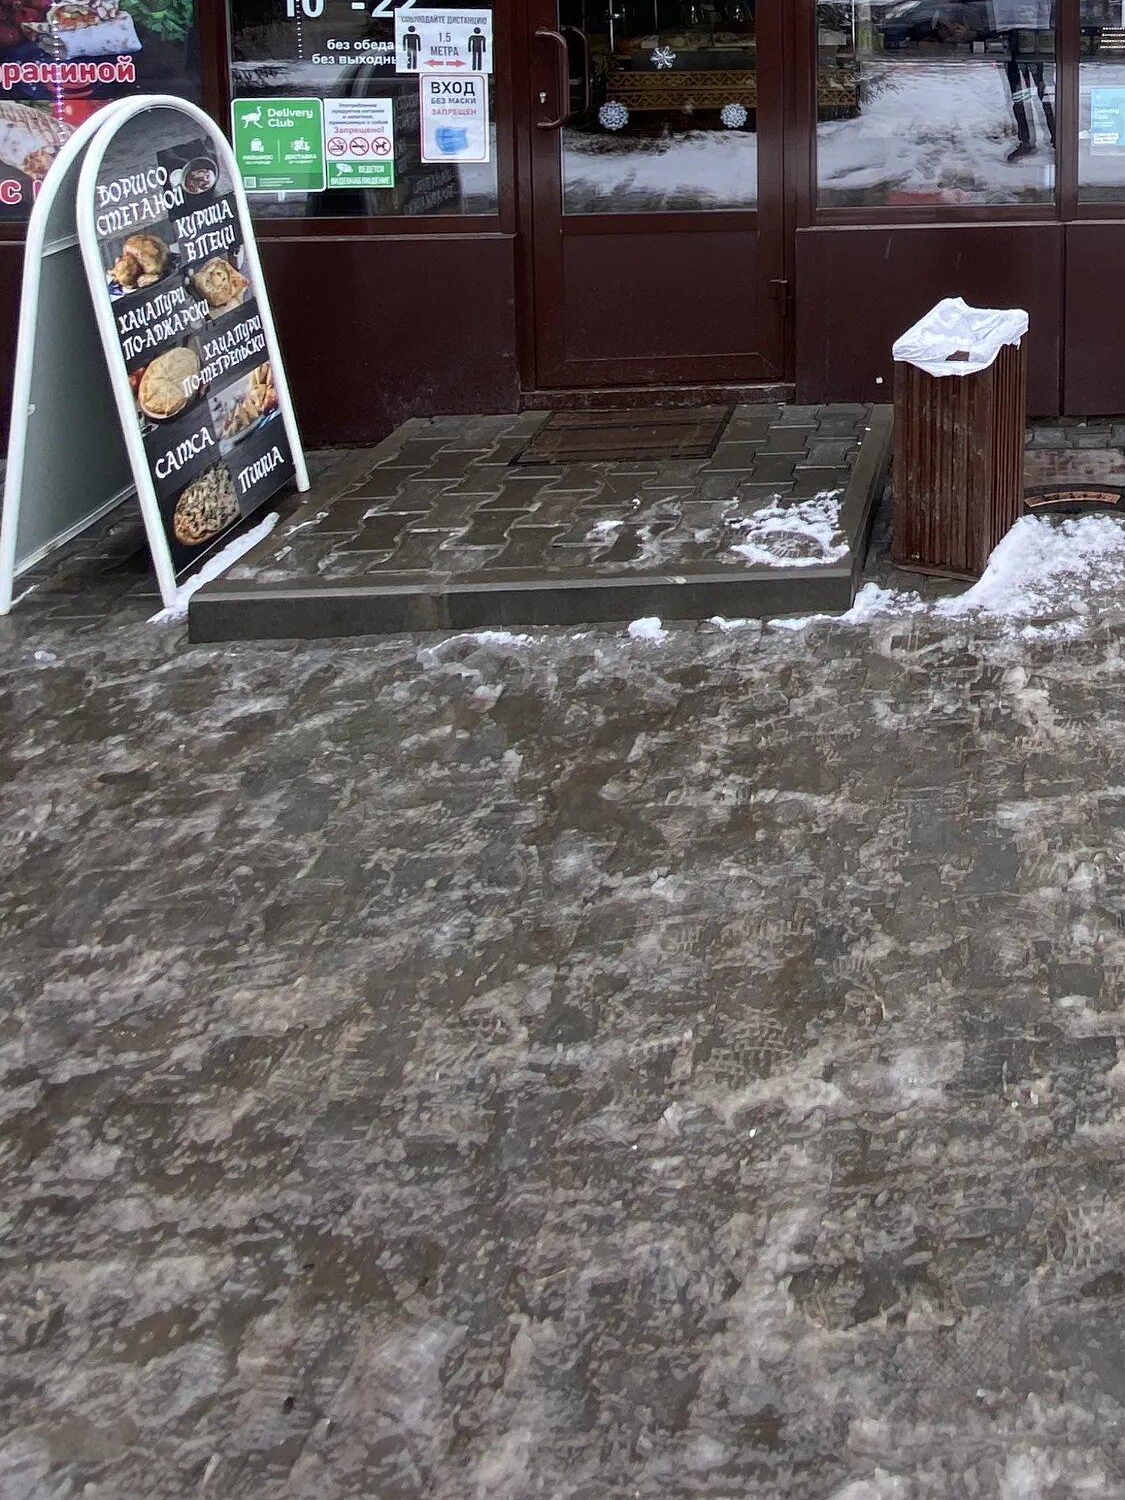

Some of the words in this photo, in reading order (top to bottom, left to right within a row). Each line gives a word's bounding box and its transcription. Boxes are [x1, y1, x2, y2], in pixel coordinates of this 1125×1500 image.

[326, 39, 352, 51] без
[354, 39, 395, 52] обеда
[430, 46, 460, 57] МЕТРА
[312, 53, 335, 65] без
[431, 81, 476, 97] ВХОД
[430, 97, 447, 105] БЕЗ
[448, 97, 477, 105] МАСКИ
[267, 107, 314, 119] Delivery
[431, 108, 477, 117] ЗАПРЕЩЕН
[267, 117, 294, 128] Club
[175, 199, 235, 240] КУРИЦА
[118, 286, 187, 335] ХАЧАПУРИ
[202, 315, 263, 361] ХАЧАПУРИ
